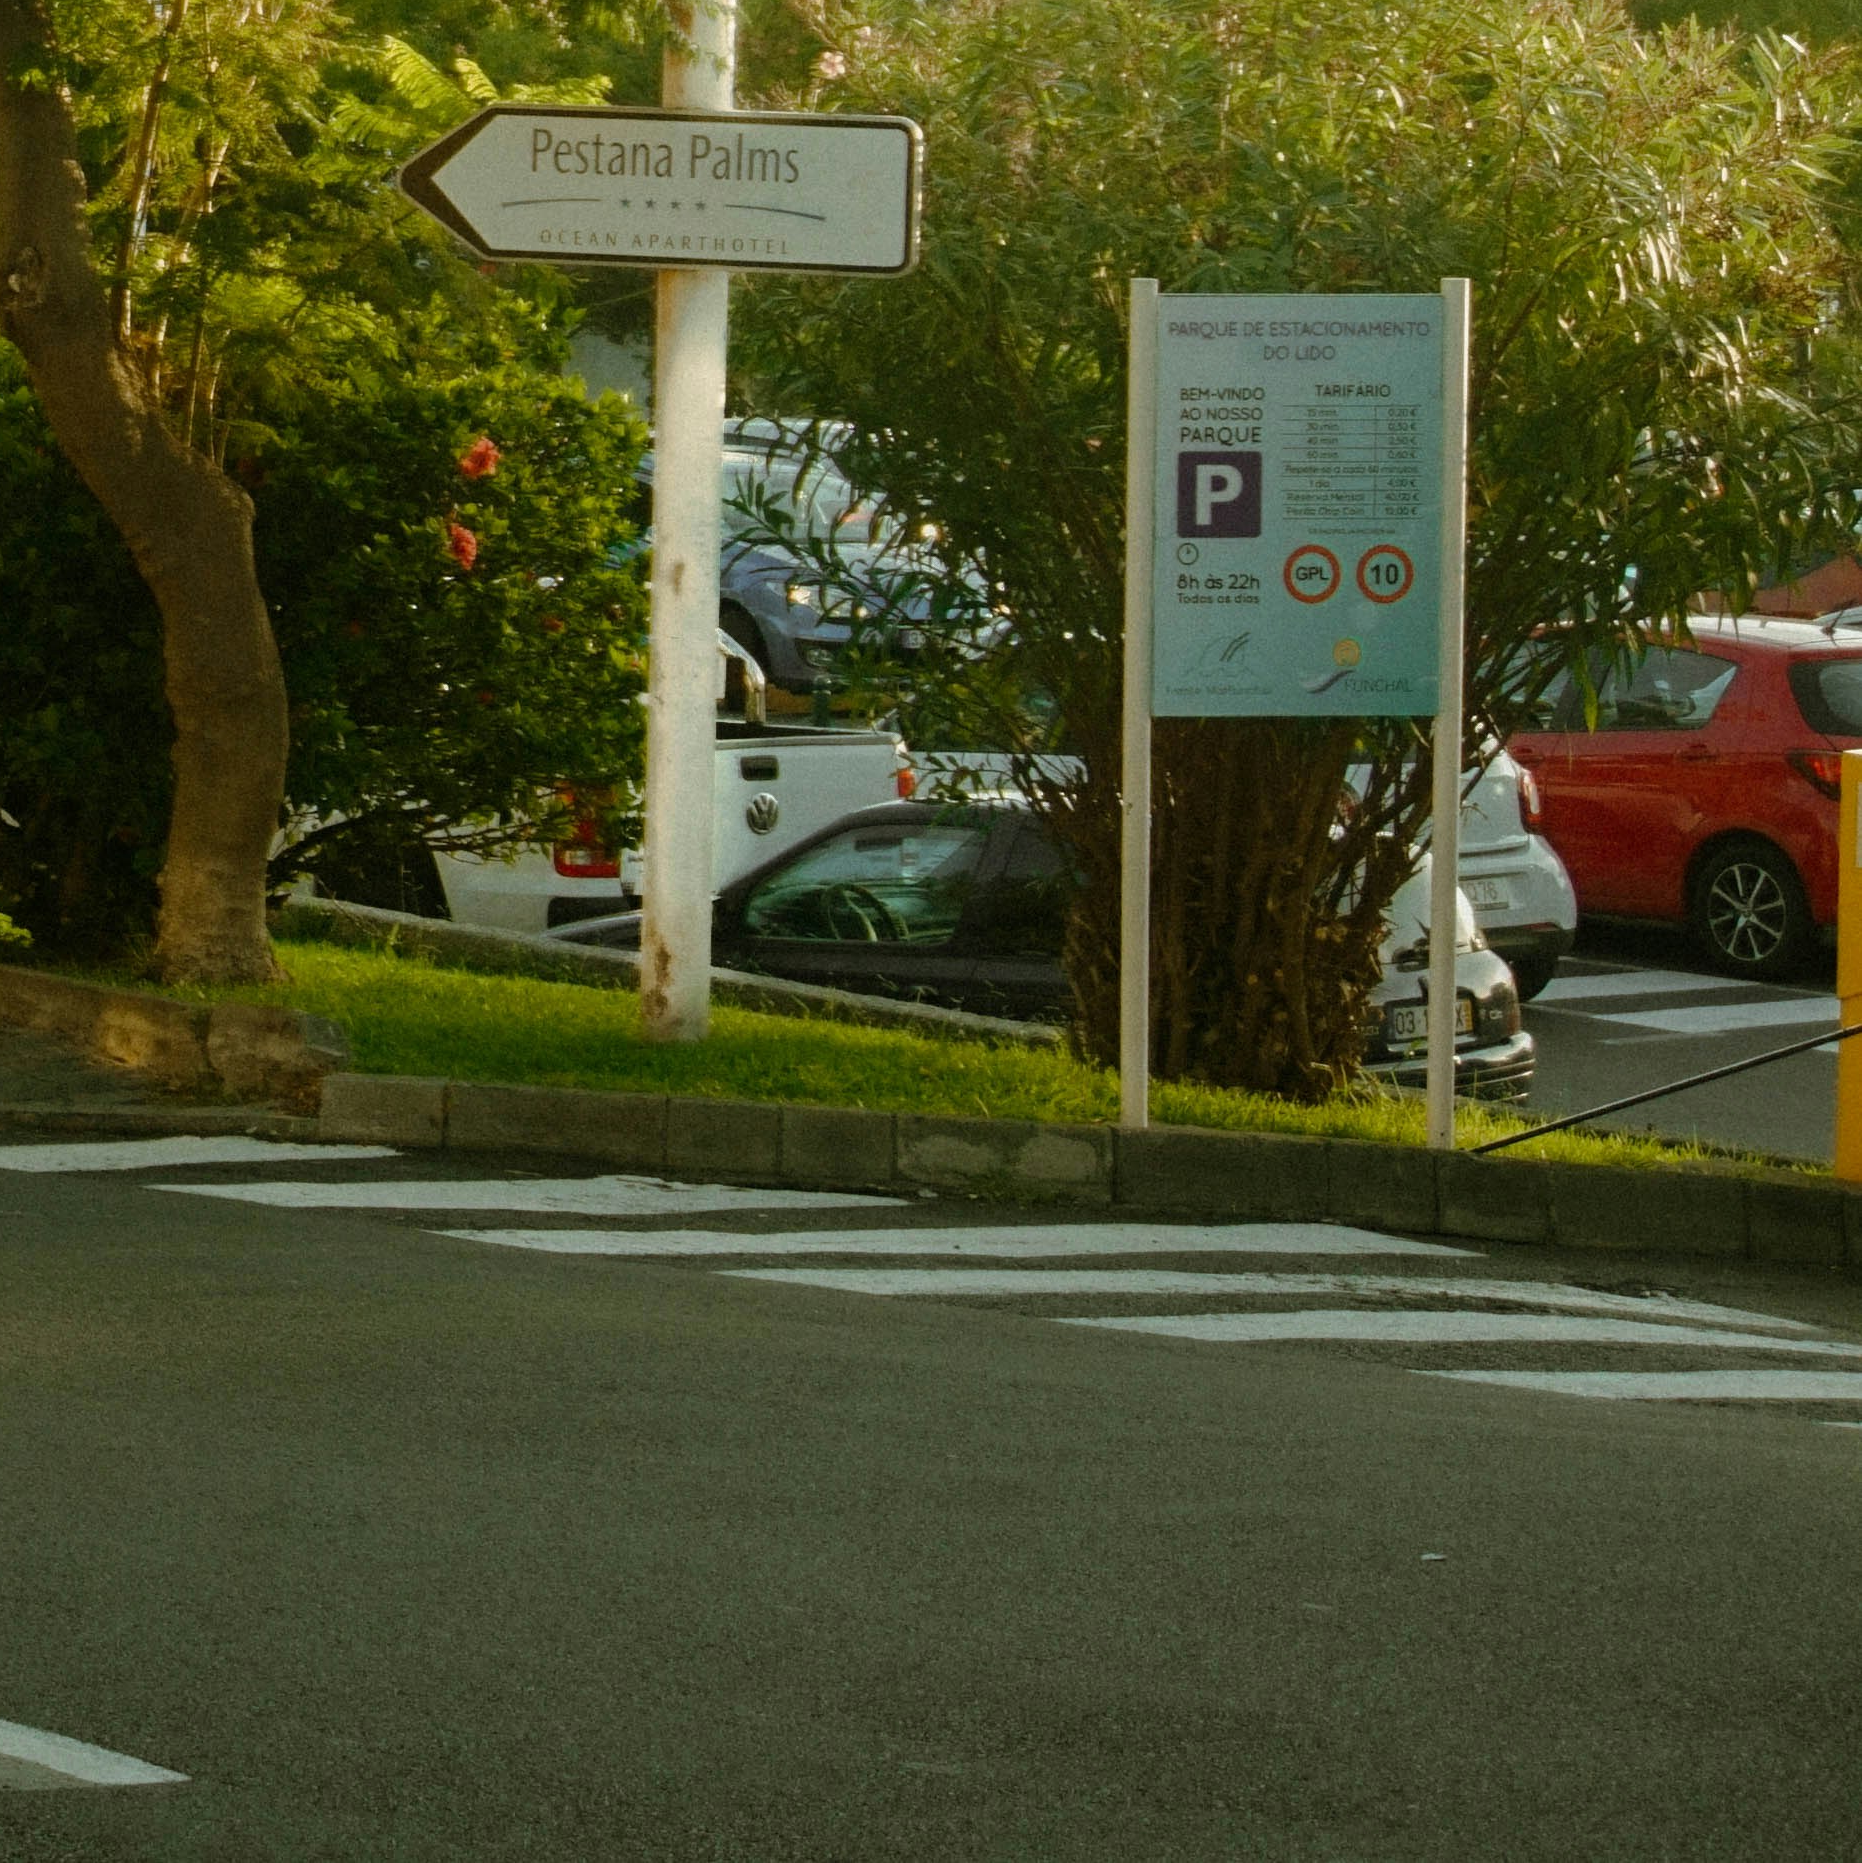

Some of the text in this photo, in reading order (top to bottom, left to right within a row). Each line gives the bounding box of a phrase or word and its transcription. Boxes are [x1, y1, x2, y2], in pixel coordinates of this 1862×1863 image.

[532, 128, 799, 183] Pestana Palms
[540, 229, 788, 255] OCEAN APARTHOTEL
[1169, 322, 1430, 339] PARQUE DE ESTACIONAMENTO
[1264, 345, 1336, 360] DO LIDO
[1180, 388, 1265, 401] BEM-VINDO
[1315, 382, 1391, 398] TARIFÁRIO
[1180, 408, 1263, 421] AO NOSSO
[1180, 427, 1263, 446] PARQUE
[1196, 464, 1243, 526] P
[1177, 574, 1200, 589] 8h
[1228, 574, 1260, 589] 22h
[1296, 567, 1329, 581] GPL
[1370, 564, 1399, 585] 10
[1177, 593, 1259, 604] Todos os dias
[1344, 679, 1413, 693] FUNCHAL
[1395, 1011, 1416, 1034] 03
